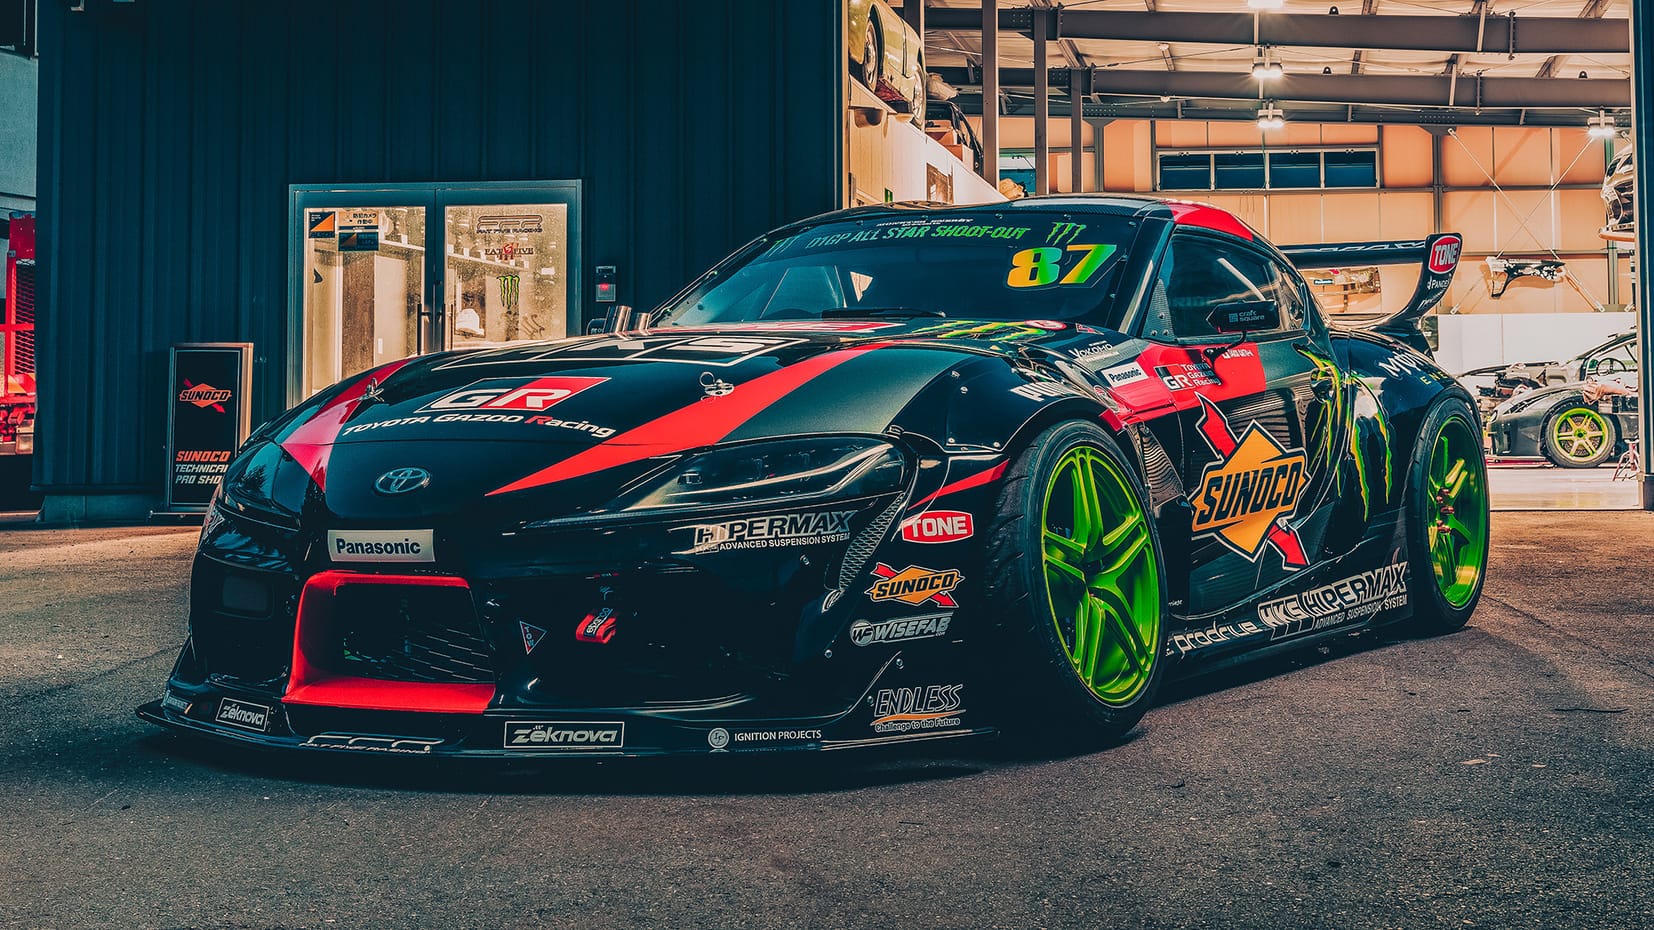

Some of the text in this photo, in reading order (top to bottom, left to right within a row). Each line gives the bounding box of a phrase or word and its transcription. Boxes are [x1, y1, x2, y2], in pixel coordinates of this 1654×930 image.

[848, 228, 881, 243] ALL
[882, 225, 931, 239] STAR
[931, 225, 1031, 240] SHOOT-OUT
[1006, 243, 1117, 288] 87
[1434, 243, 1458, 267] TONE
[1108, 368, 1142, 383] Panasonic
[1180, 362, 1211, 371] TOYOTA
[1163, 374, 1193, 390] GR
[181, 391, 228, 400] SUNOCO
[430, 388, 572, 408] GR
[342, 413, 617, 438] TOYOTA GAZOO Racing
[176, 451, 231, 462] SUNOCO
[176, 475, 223, 484] PRO SHO
[1196, 461, 1302, 525] SUNOCO
[695, 510, 858, 546] HIPERMAX
[911, 516, 968, 538] TONE
[336, 538, 421, 555] Panasonic
[719, 540, 768, 551] ADVANCED
[768, 536, 820, 547] SUSPENSION
[821, 532, 850, 543] SYSTEM
[875, 573, 956, 598] SUNOCO
[1258, 561, 1408, 629] HKS HIPERMAX
[1314, 593, 1408, 630] ADVANCED SUSPENSION SYSTEM
[874, 617, 951, 640] WISEFAB
[1173, 620, 1263, 660] prodrive
[873, 683, 963, 717] ENDLESS
[875, 717, 960, 732] Challenge to the Future
[734, 730, 822, 742] IGNITION PROJECTS
